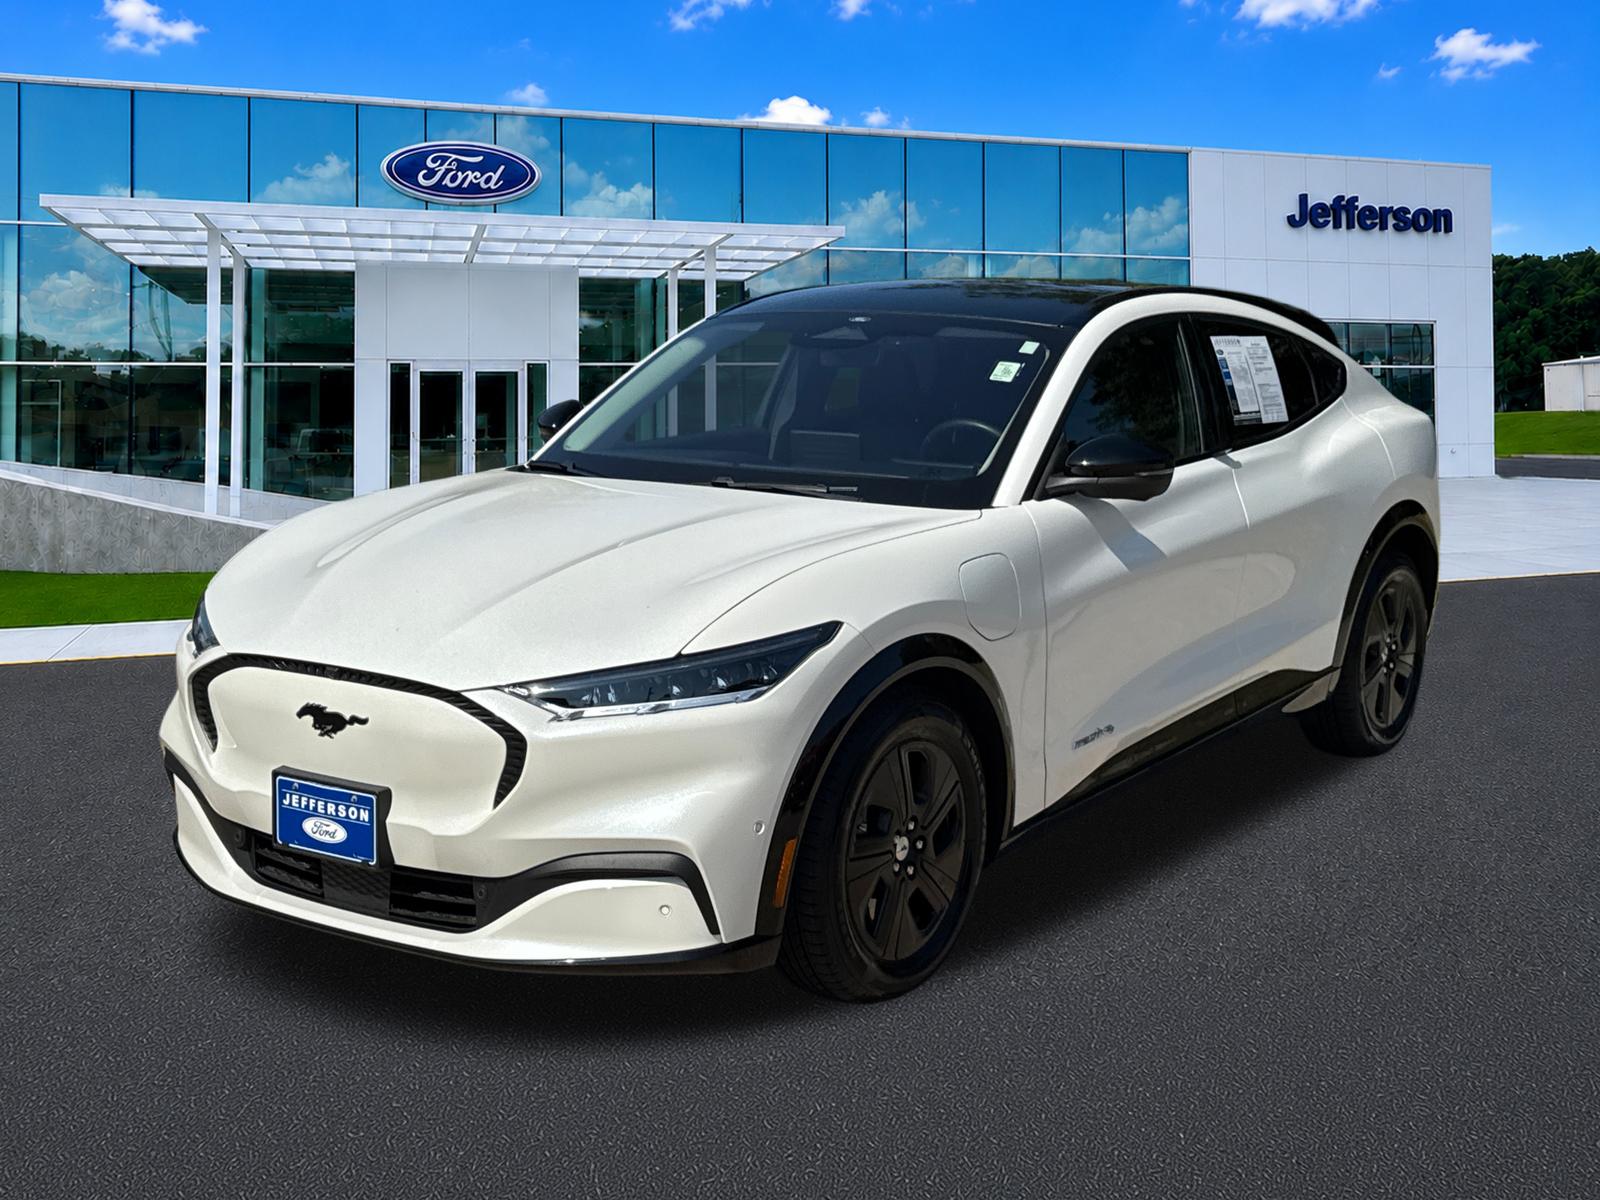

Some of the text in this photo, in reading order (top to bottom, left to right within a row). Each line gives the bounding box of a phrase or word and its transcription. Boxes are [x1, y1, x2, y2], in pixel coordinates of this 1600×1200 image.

[417, 152, 505, 189] Ford
[1286, 193, 1453, 233] Jefferson
[282, 793, 369, 822] JEFFERSON
[311, 820, 337, 839] Ford
